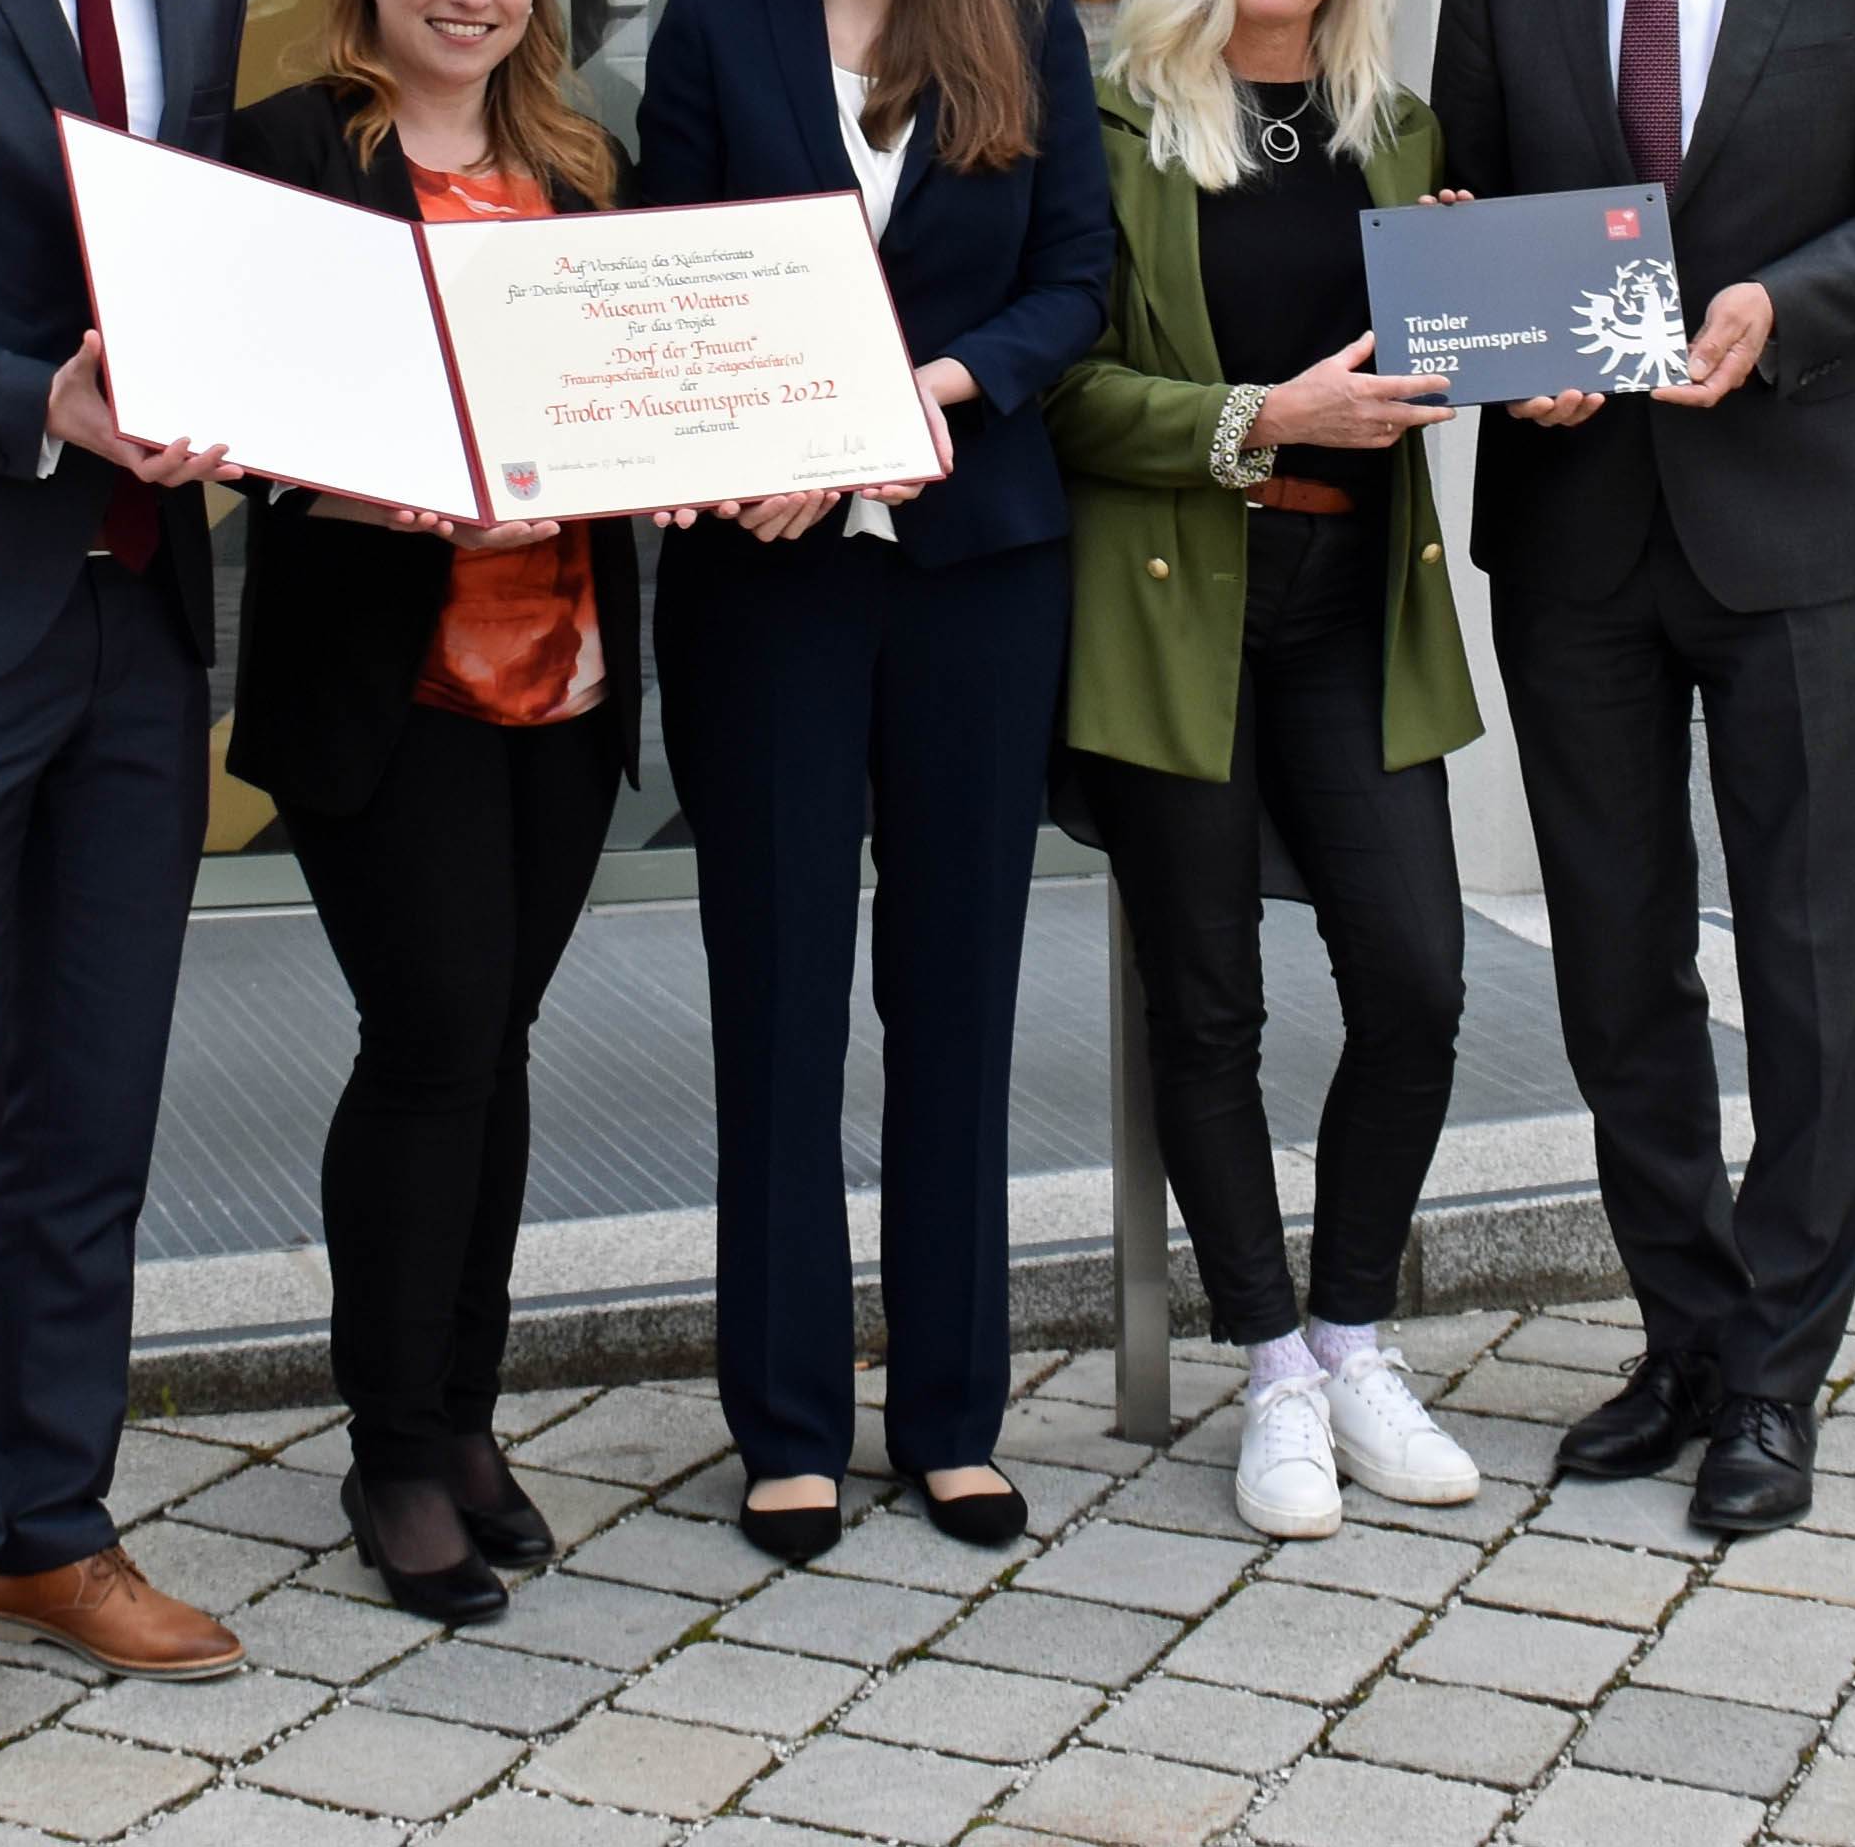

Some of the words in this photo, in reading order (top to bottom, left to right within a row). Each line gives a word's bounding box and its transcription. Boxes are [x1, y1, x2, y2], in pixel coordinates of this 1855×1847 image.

[651, 254, 671, 268] des
[625, 276, 650, 290] und
[581, 298, 667, 320] Museum
[670, 291, 750, 313] Wattens
[626, 320, 647, 340] für
[651, 318, 672, 332] das
[676, 316, 717, 334] Projekt
[1405, 313, 1469, 333] Tiroler
[662, 341, 688, 359] der
[1408, 326, 1549, 355] Museumspreis
[684, 362, 703, 376] als
[1410, 355, 1460, 374] 2022
[679, 380, 699, 392] der
[545, 401, 614, 426] Tiroler
[619, 387, 770, 419] Museumspreis
[778, 379, 839, 404] 2022
